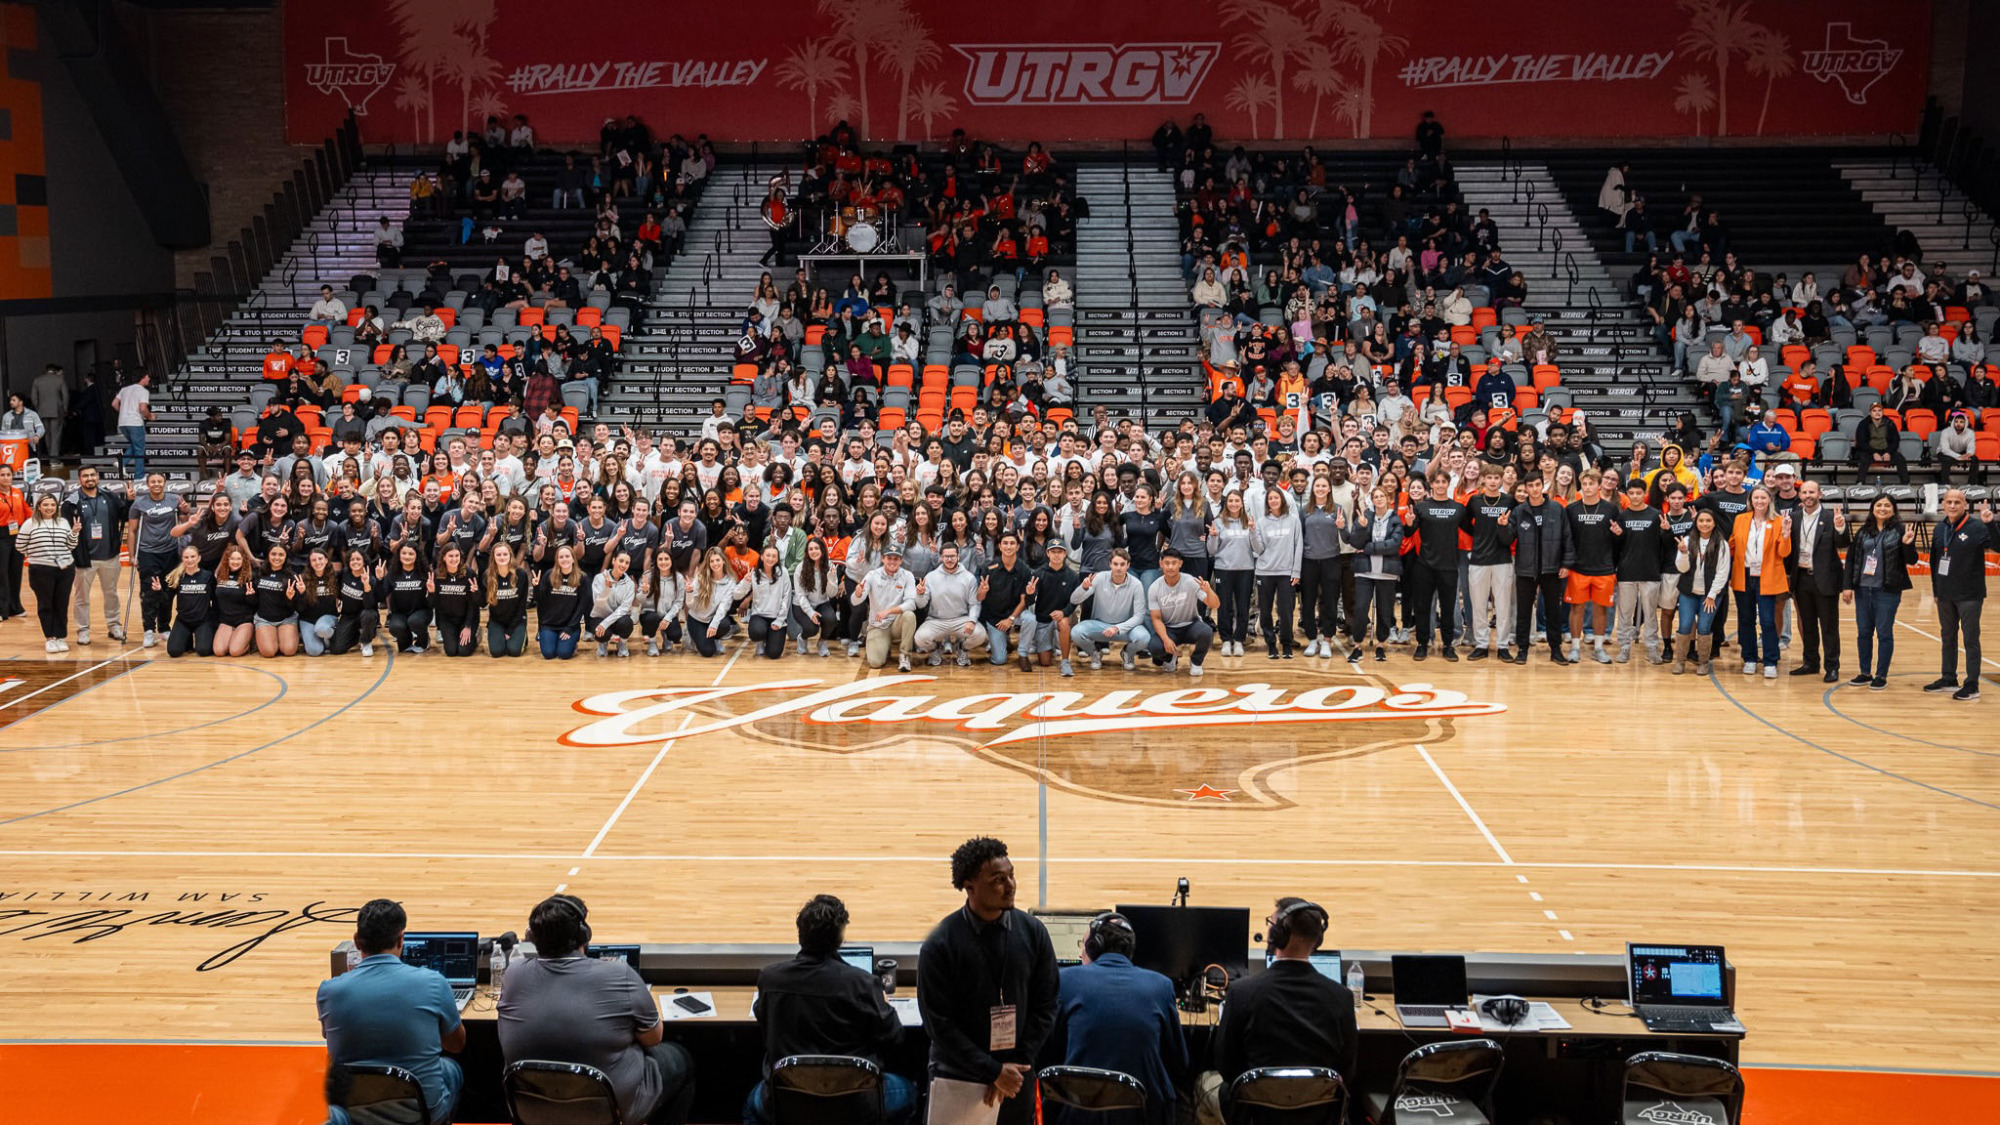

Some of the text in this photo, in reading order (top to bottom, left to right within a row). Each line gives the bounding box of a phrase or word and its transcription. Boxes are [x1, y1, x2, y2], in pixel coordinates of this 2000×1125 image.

[1801, 49, 1904, 73] UTRGV
[304, 63, 397, 85] UTRGV
[505, 59, 768, 93] #RALLY THE VALLEY
[949, 42, 1222, 105] UTRGV
[1398, 51, 1675, 87] #RALLY THE VALLEY
[1560, 311, 1588, 319] UTRGV
[740, 337, 754, 351] 3
[1582, 347, 1612, 355] UTRGV
[337, 350, 348, 364] 3
[463, 351, 474, 364] 3
[995, 345, 1008, 358] 3
[515, 364, 524, 377] 3
[1449, 374, 1460, 386] 3
[1288, 394, 1300, 408] 3
[1323, 394, 1335, 408] 3
[1494, 394, 1506, 407] 3
[3, 445, 13, 455] G
[556, 675, 1508, 751] Vaqueros
[177, 892, 269, 902] SAM
